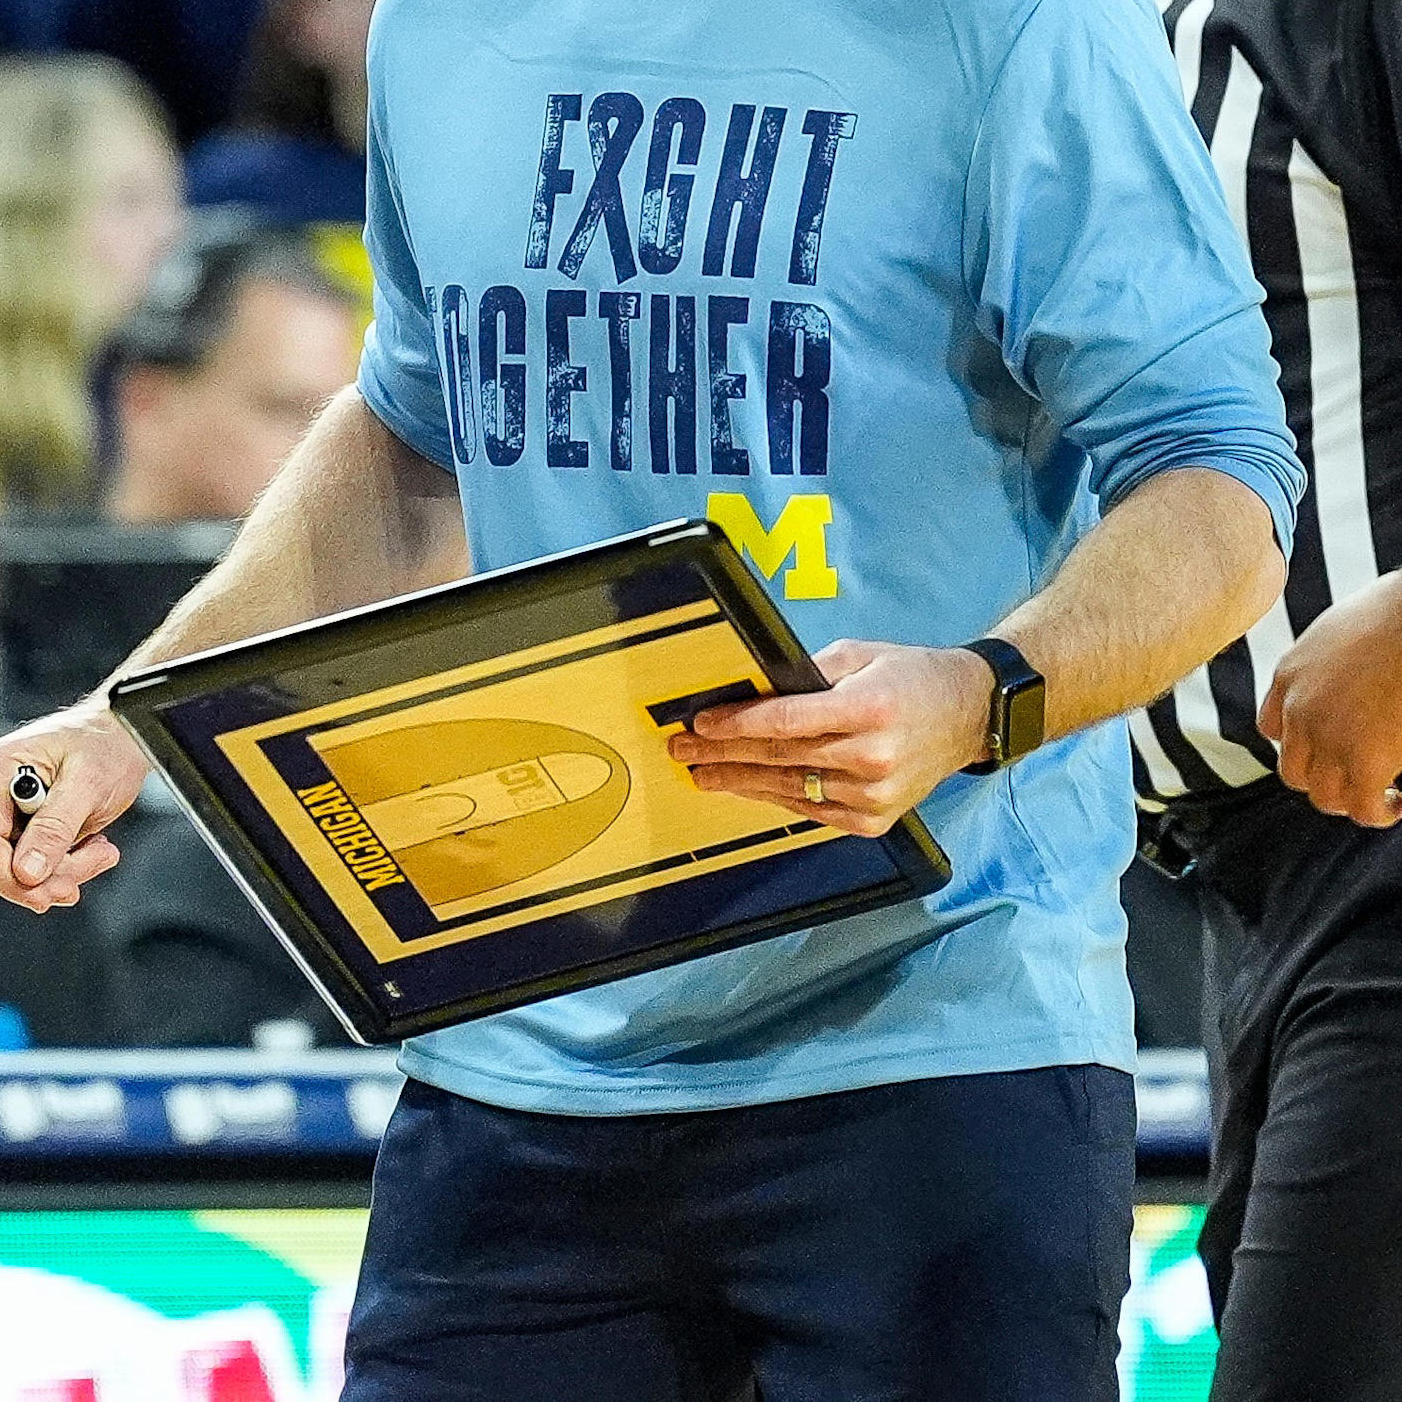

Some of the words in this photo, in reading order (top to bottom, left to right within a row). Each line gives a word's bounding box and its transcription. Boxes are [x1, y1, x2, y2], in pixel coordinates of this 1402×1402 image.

[425, 285, 831, 476] OGETHER
[706, 492, 839, 600] M
[297, 780, 406, 892] MICHIGAN
